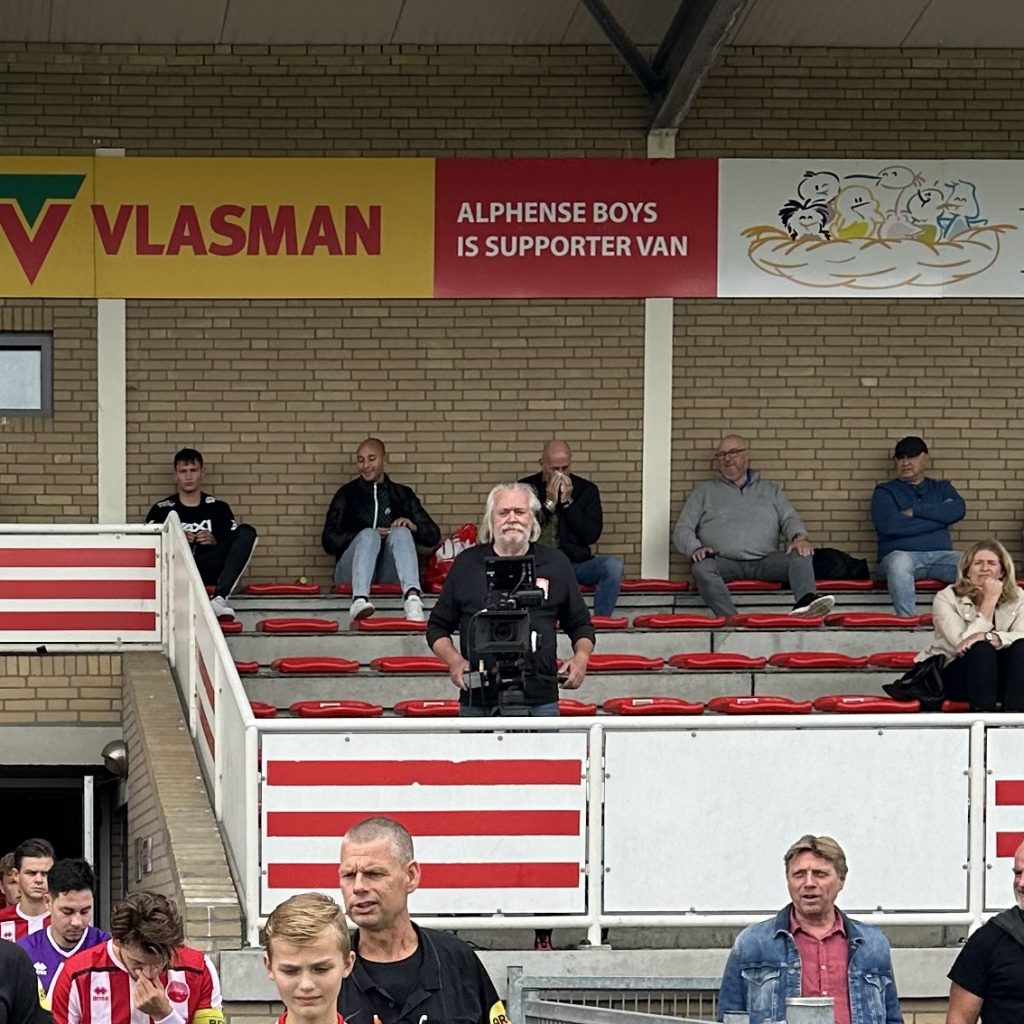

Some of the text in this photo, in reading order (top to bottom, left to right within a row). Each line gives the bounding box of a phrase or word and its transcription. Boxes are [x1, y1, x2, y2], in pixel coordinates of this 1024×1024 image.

[456, 201, 658, 224] ALPHENSE BOYS
[90, 203, 382, 257] VLASMAN
[456, 235, 689, 258] IS SUPPORTER VAN
